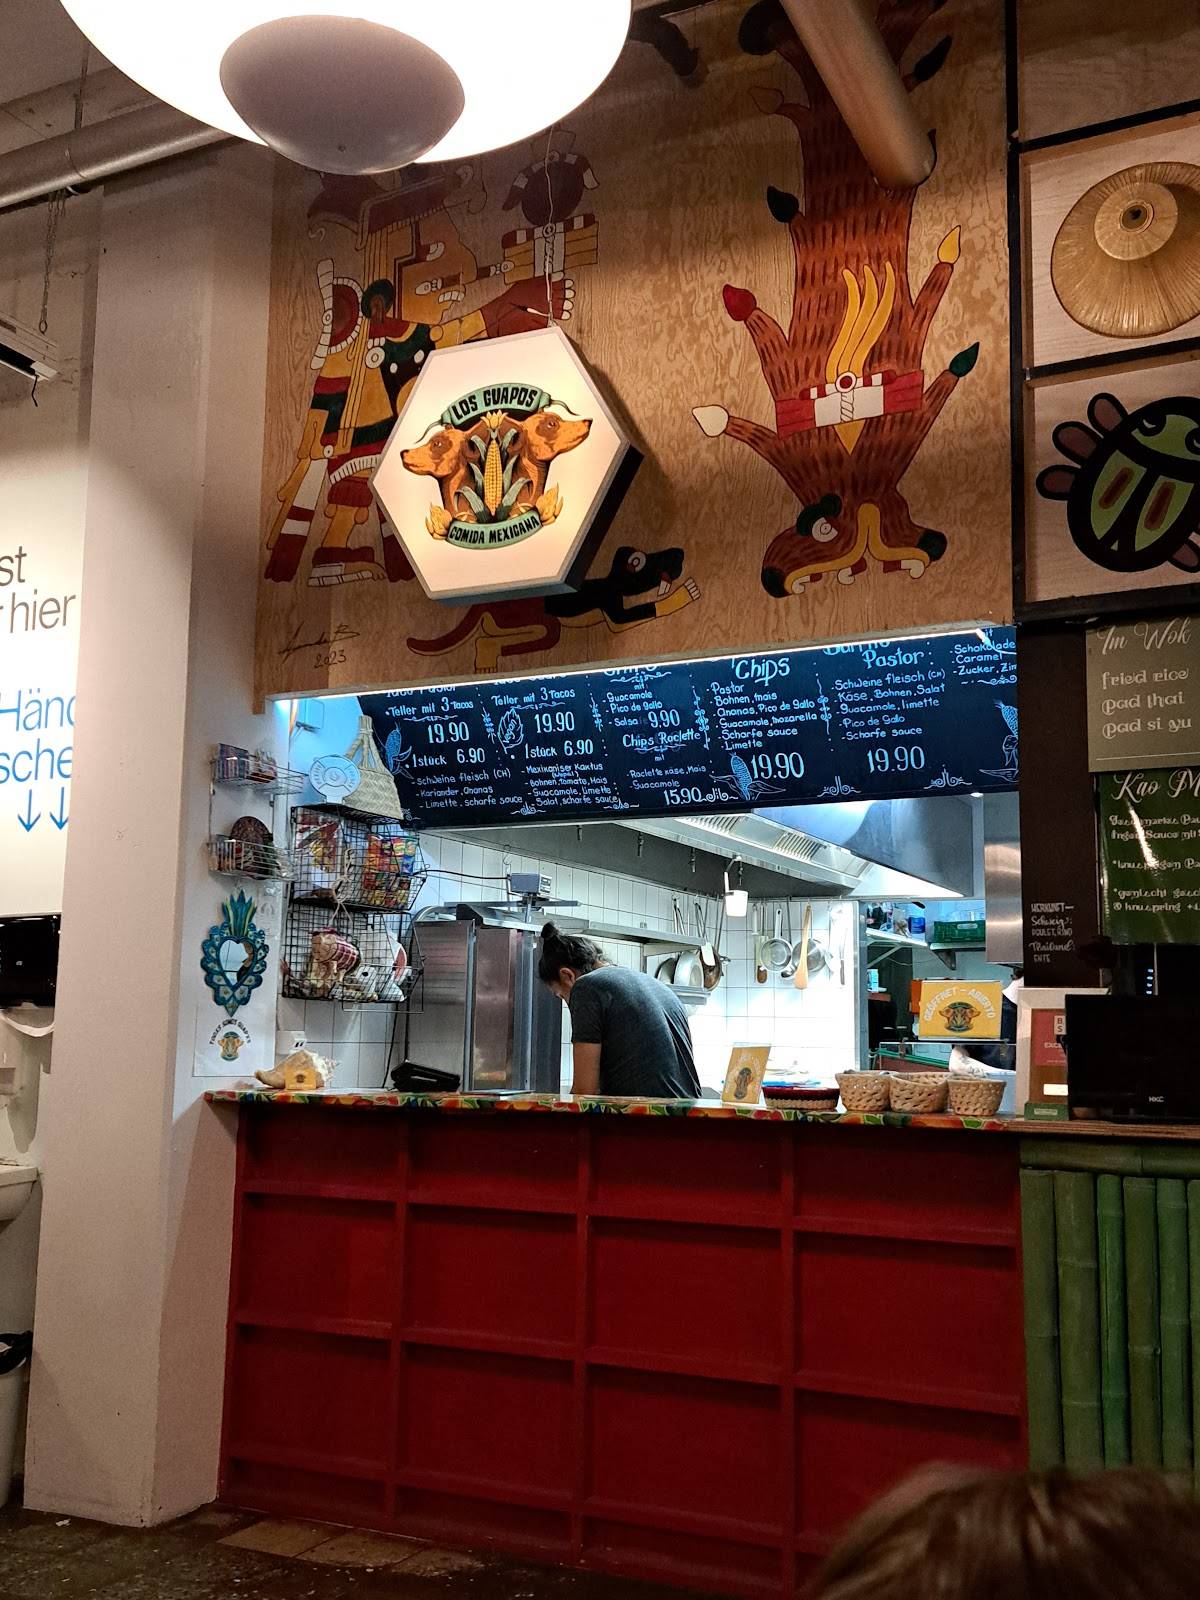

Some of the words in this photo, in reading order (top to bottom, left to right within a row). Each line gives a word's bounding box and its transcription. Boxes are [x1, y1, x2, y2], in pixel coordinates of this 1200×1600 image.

[451, 396, 478, 420] LOS
[484, 387, 538, 408] GUAPOS
[449, 526, 485, 545] COMIDA
[489, 516, 540, 543] MEXICANA
[10, 588, 76, 634] hier
[1097, 625, 1128, 655] Im
[1134, 616, 1192, 650] Wok
[954, 639, 1016, 655] Schokolade
[862, 647, 925, 669] Pastor
[956, 653, 1003, 664] Caramel
[735, 658, 791, 686] Chips
[834, 678, 883, 690] Schweine
[885, 671, 925, 684] fleisch
[1153, 668, 1190, 682] rice
[491, 695, 518, 707] Teller
[523, 692, 535, 703] mit
[540, 687, 548, 701] 3
[710, 681, 745, 695] Pastor
[916, 683, 946, 694] Salat
[389, 706, 417, 717] Teller
[422, 703, 436, 714] mit
[441, 696, 450, 712] 3
[610, 703, 629, 714] Pico
[631, 702, 641, 711] de
[758, 704, 778, 713] Pico
[780, 702, 791, 712] de
[534, 711, 575, 734] 19.90
[614, 716, 638, 727] Salsa
[647, 708, 680, 728] 9.90
[842, 718, 865, 728] Pico
[867, 716, 880, 726] de
[1147, 717, 1164, 731] si
[427, 721, 470, 744] 19.90
[622, 733, 655, 748] Chips
[657, 729, 701, 744] Raclette
[767, 727, 798, 737] sauce
[891, 727, 923, 737] sauce
[564, 738, 594, 757] 6.90
[724, 740, 763, 751] Limette
[456, 747, 486, 764] 6.90
[867, 746, 925, 773] 19.90
[459, 770, 490, 783] fleisch
[493, 767, 511, 779] (CH)
[751, 752, 805, 780] 19.90
[663, 786, 701, 806] 15.90
[1111, 771, 1160, 804] Kao
